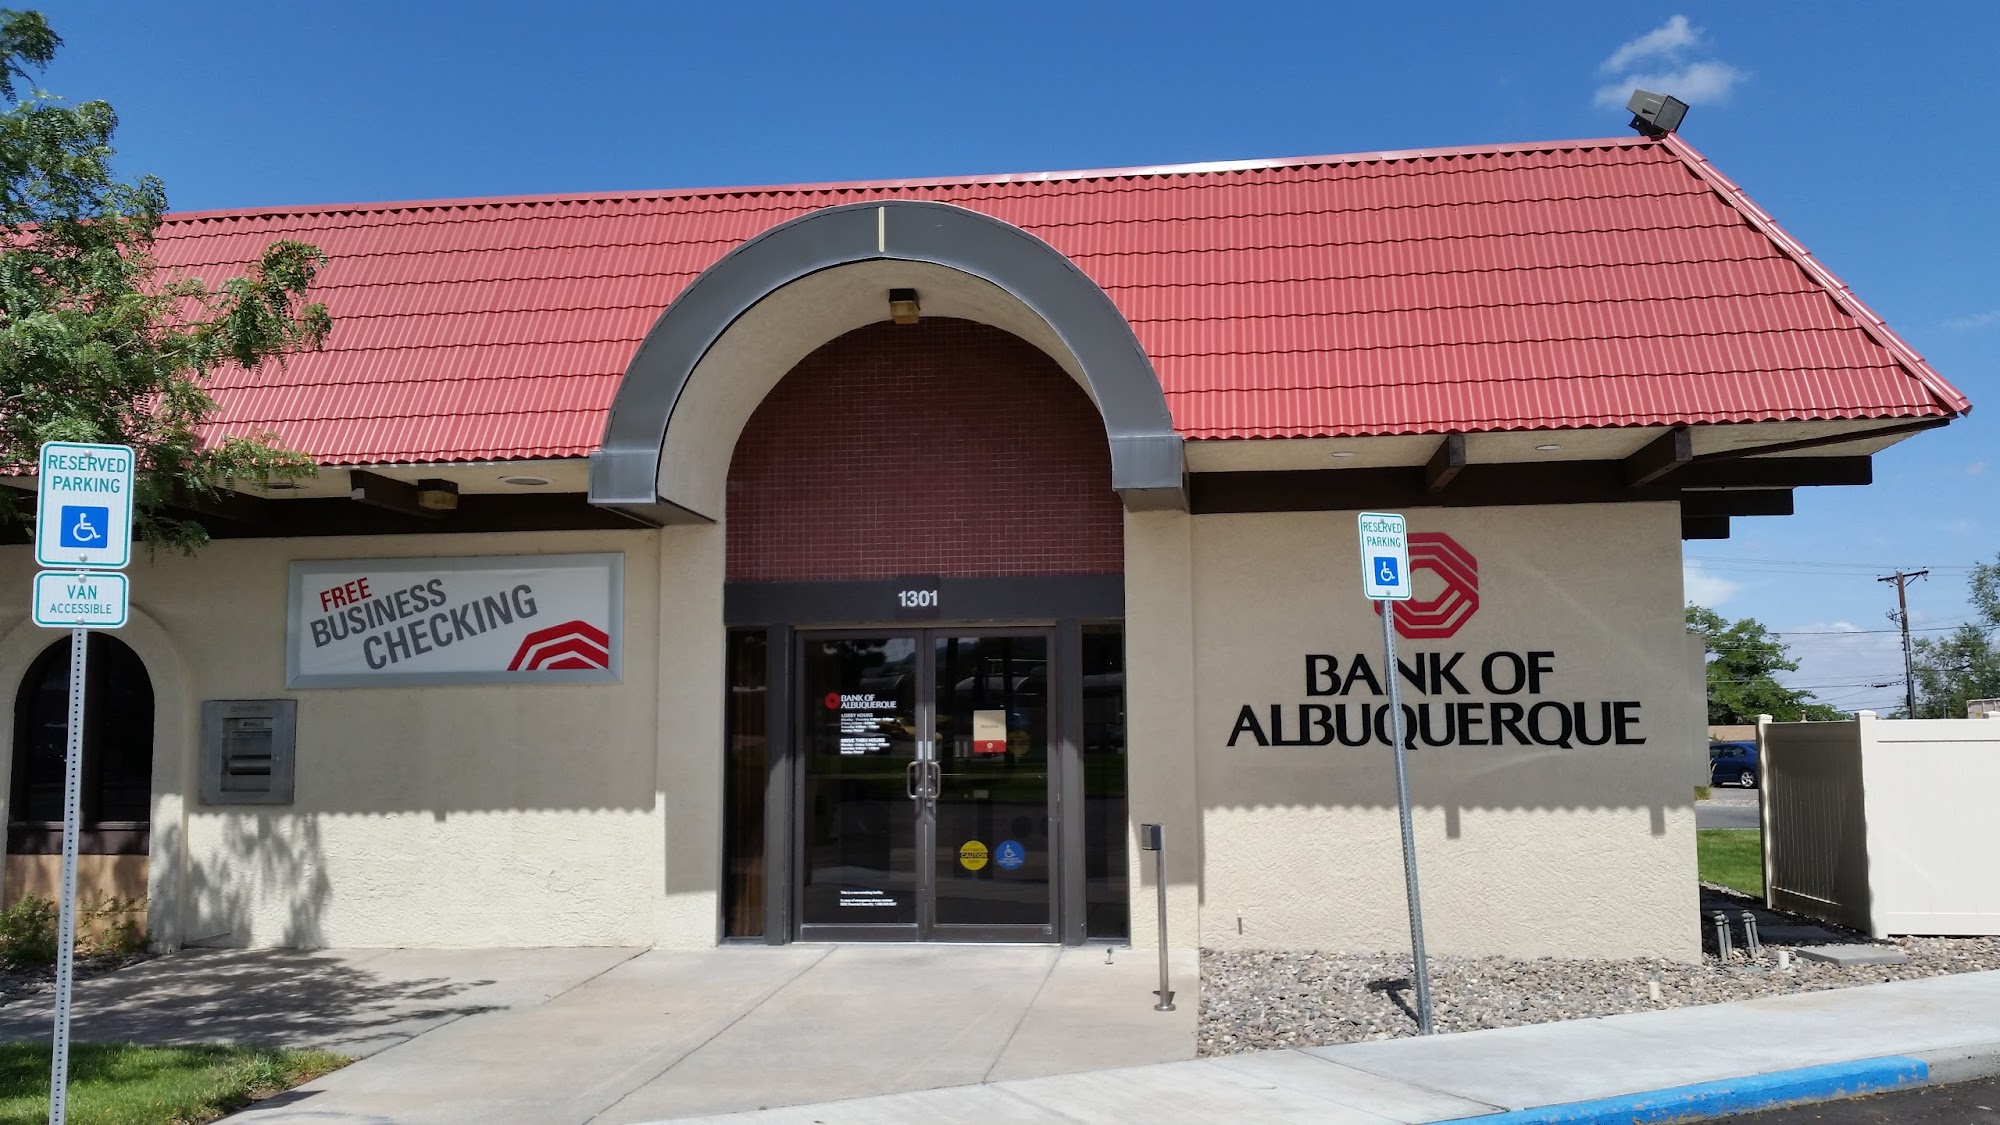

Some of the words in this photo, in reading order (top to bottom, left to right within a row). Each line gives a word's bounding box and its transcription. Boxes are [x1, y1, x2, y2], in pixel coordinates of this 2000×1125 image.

[48, 454, 126, 473] RESERVED
[52, 475, 120, 493] PARKING
[1363, 521, 1402, 533] RESERVED
[1366, 536, 1401, 547] PARKING
[67, 585, 97, 600] VAN
[319, 577, 373, 613] FREE
[898, 590, 938, 607] 1301
[50, 603, 112, 614] ACCESSIBLE
[310, 578, 447, 648] BUSINESS
[362, 584, 538, 670] CHECKING
[1305, 652, 1471, 696] BANK
[1481, 651, 1555, 695] OF
[841, 694, 863, 702] BANK
[864, 694, 875, 702] OF
[841, 701, 897, 709] ALBUQUERQUE
[1226, 701, 1647, 750] ALBUQUERQUE
